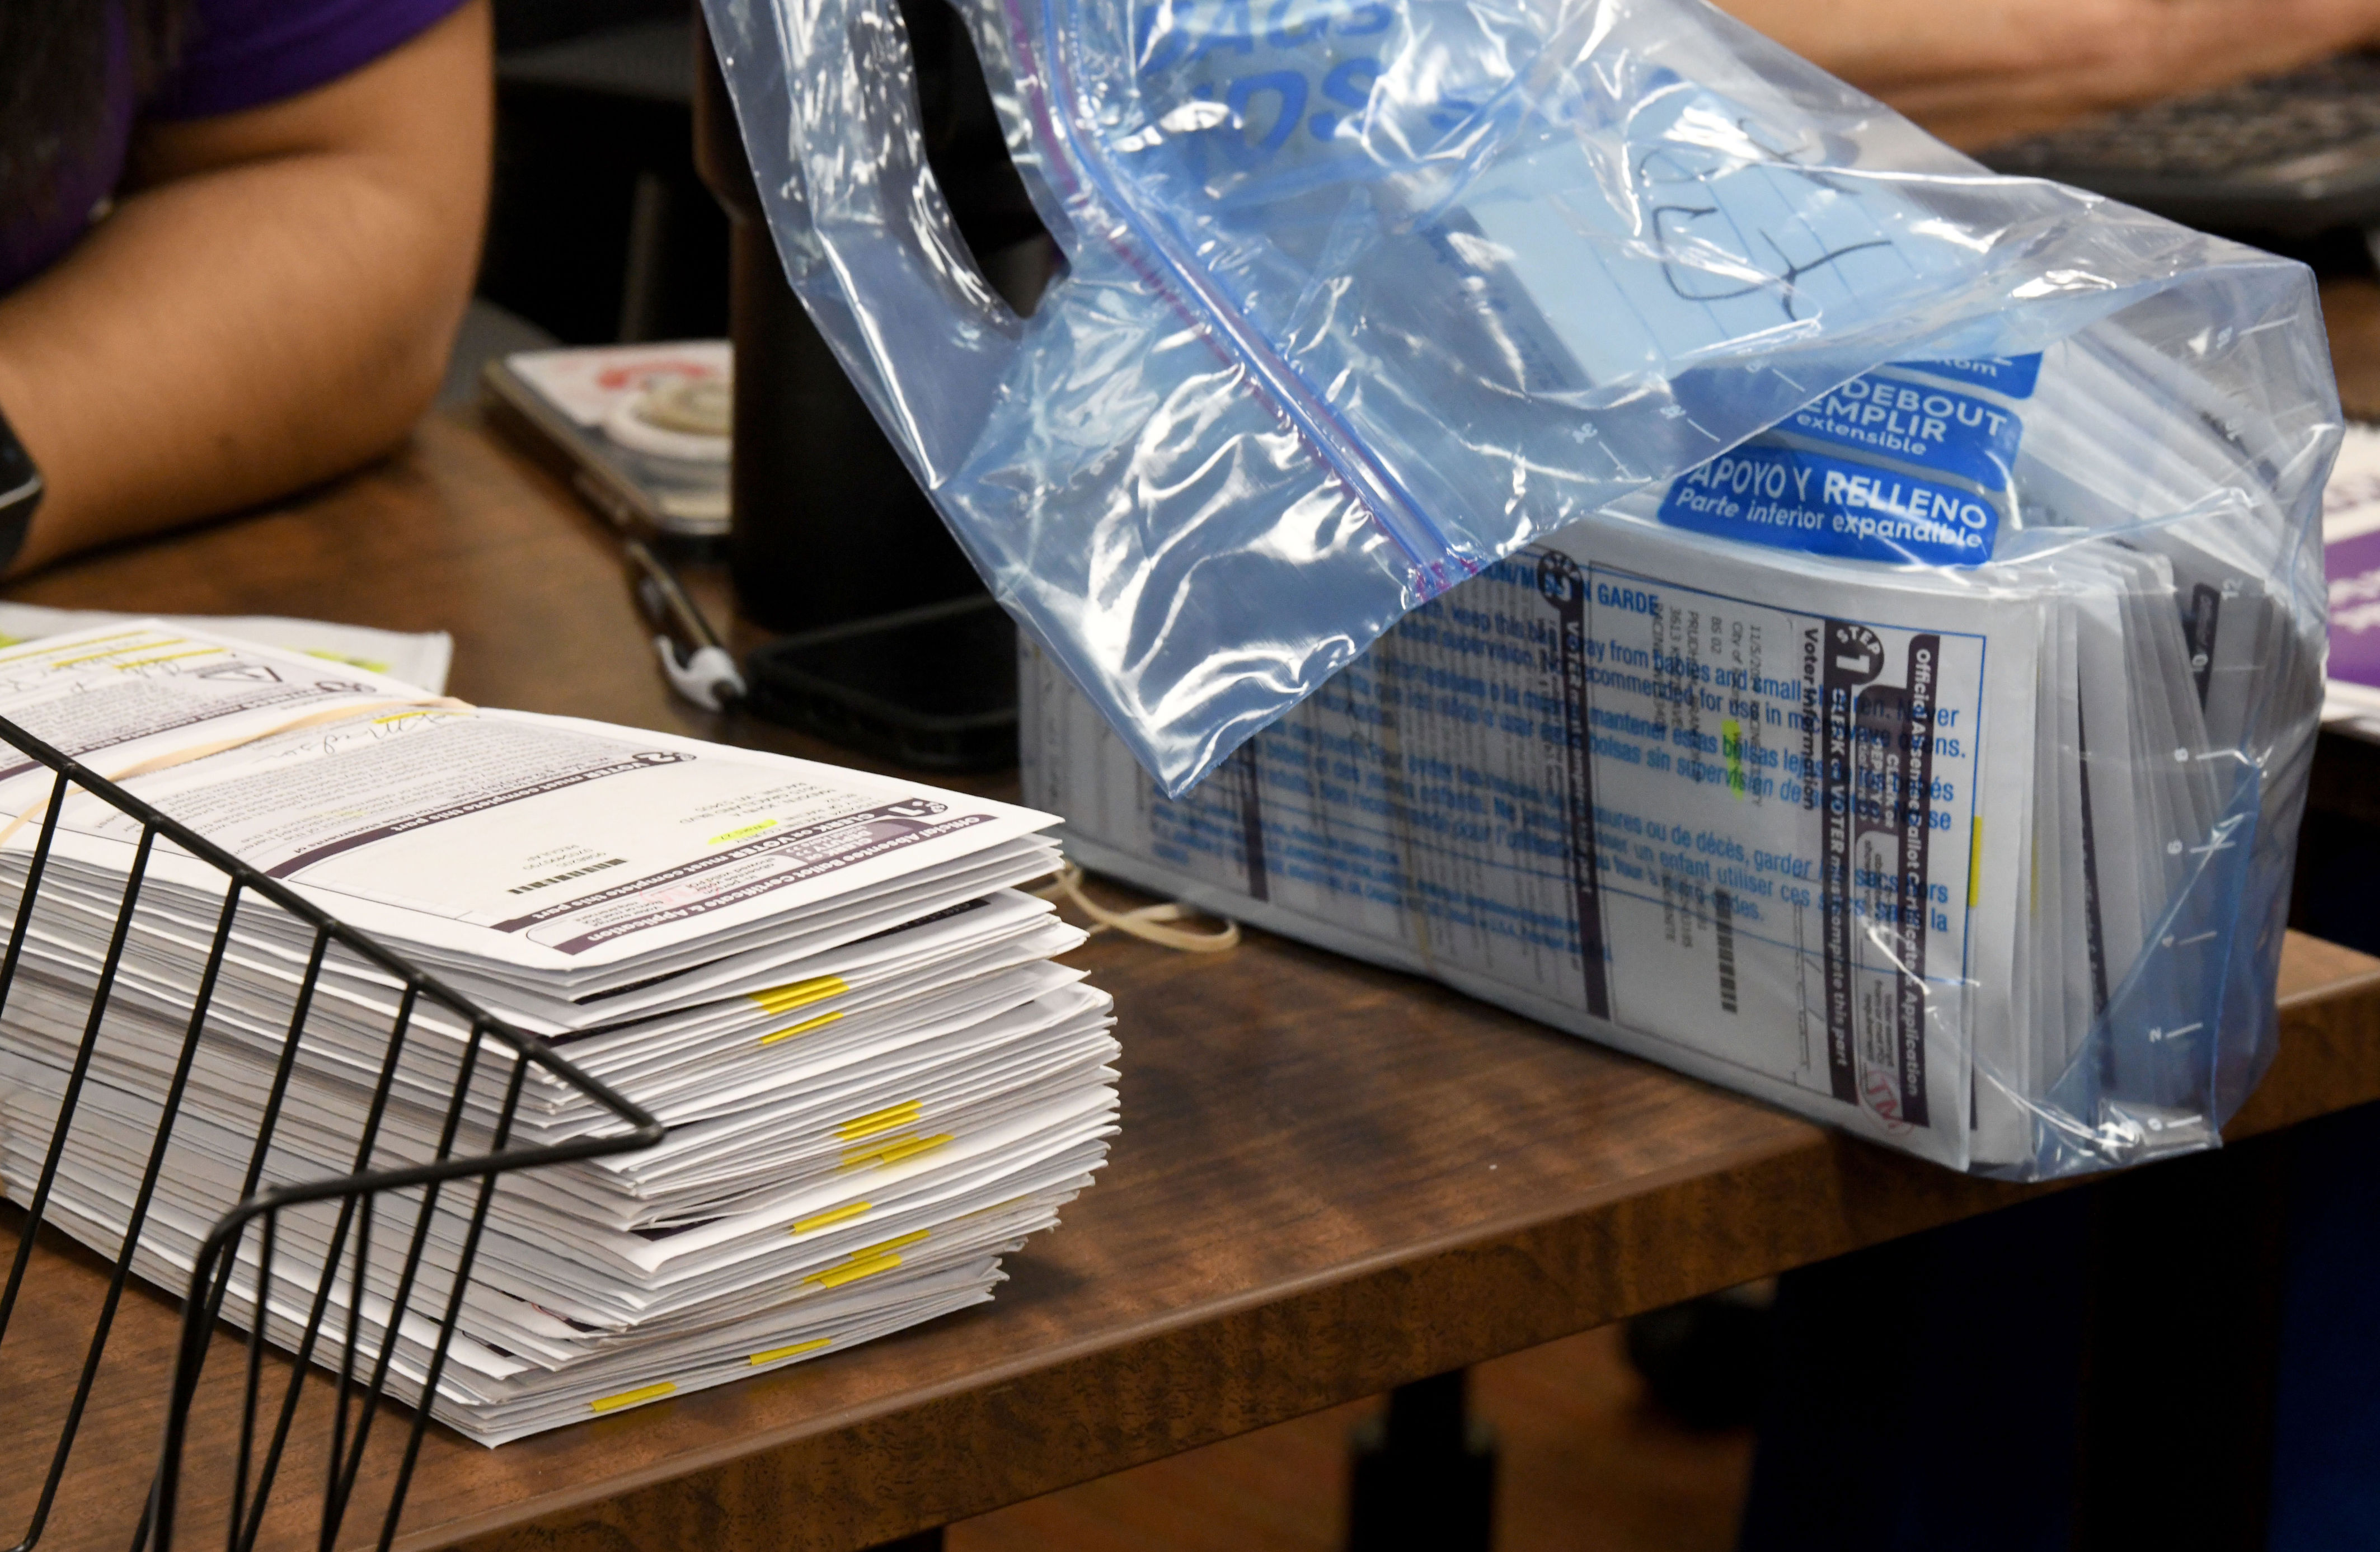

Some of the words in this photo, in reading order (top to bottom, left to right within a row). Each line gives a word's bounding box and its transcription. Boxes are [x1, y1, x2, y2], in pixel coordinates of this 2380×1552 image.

[1841, 379, 2008, 437] DEBOUT
[1796, 413, 1927, 456] extensible
[1687, 457, 1787, 498] APOYO
[1794, 467, 1813, 502] Y
[1824, 470, 1988, 530] RELLENO
[1676, 486, 1740, 519] Parte
[1747, 500, 1825, 531] inferior
[1833, 513, 1983, 549] expandible
[1598, 583, 1660, 616] GARDE
[1609, 639, 1649, 669] from
[1836, 625, 1881, 656] STEP
[1802, 627, 1819, 687] Voter
[1836, 655, 1870, 674] 1
[1698, 688, 1724, 713] for
[1765, 703, 1782, 726] in
[463, 785, 542, 815] complete
[389, 815, 429, 833] part
[727, 834, 794, 860] VOTER
[842, 831, 920, 862] Absentee
[680, 854, 730, 878] must
[792, 858, 843, 877] Ballot
[1754, 848, 1813, 881] garder
[607, 870, 682, 899] complete
[703, 874, 795, 910] Certificate
[1717, 866, 1774, 898] utiliser
[531, 902, 569, 919] part
[571, 890, 607, 910] this
[586, 909, 687, 942] Application
